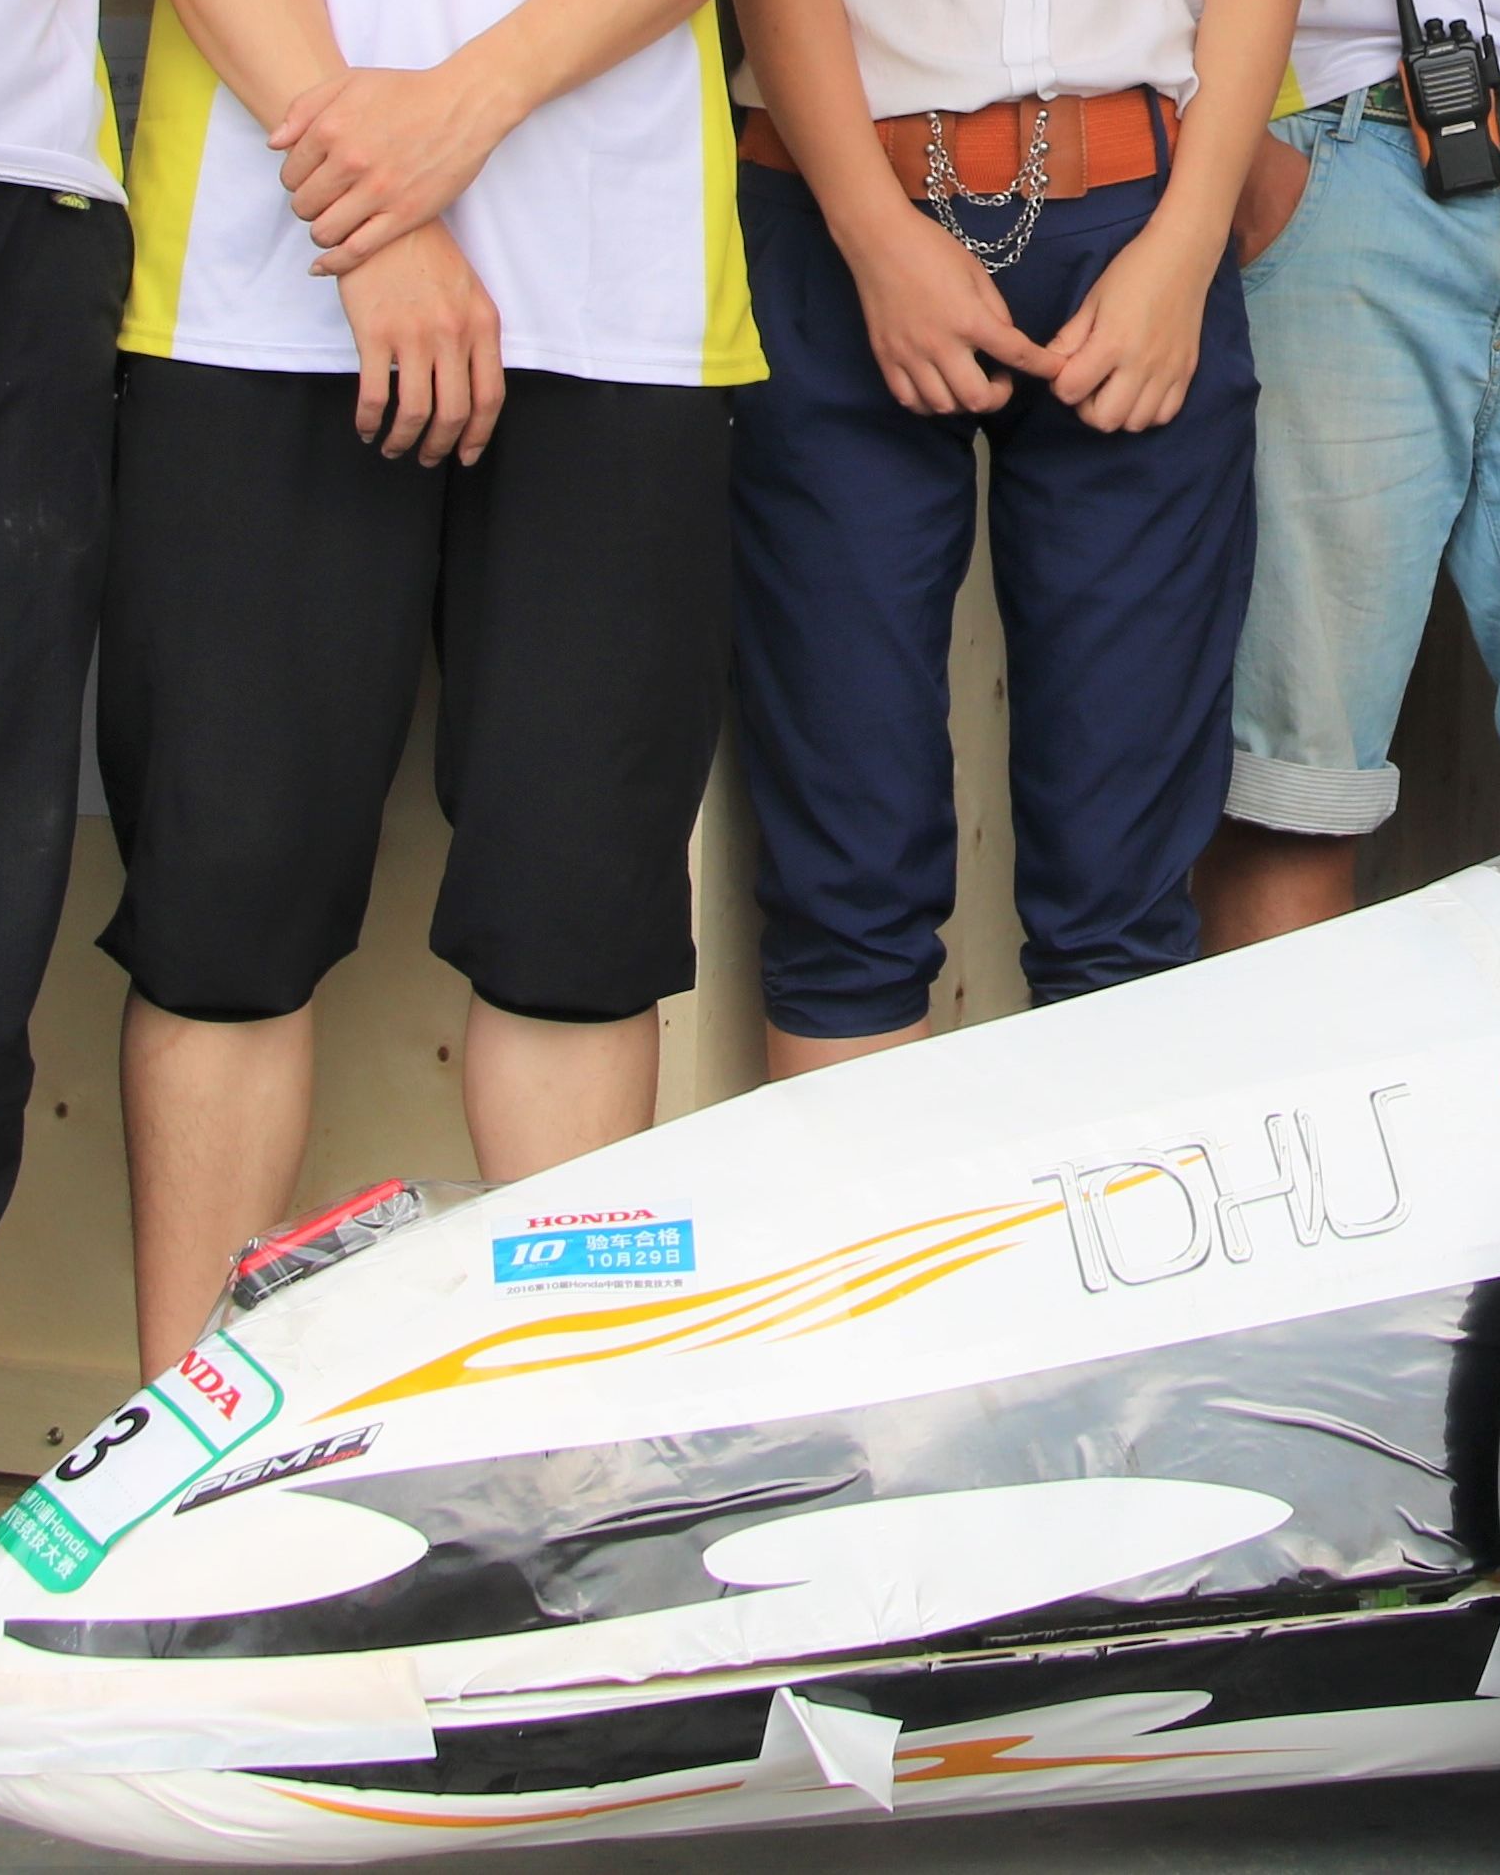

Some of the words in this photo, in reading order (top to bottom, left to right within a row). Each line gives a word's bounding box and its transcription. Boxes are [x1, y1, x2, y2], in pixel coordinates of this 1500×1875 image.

[526, 1208, 658, 1230] HONDA
[586, 1227, 681, 1251] 验车合格
[586, 1248, 681, 1268] 10月29日
